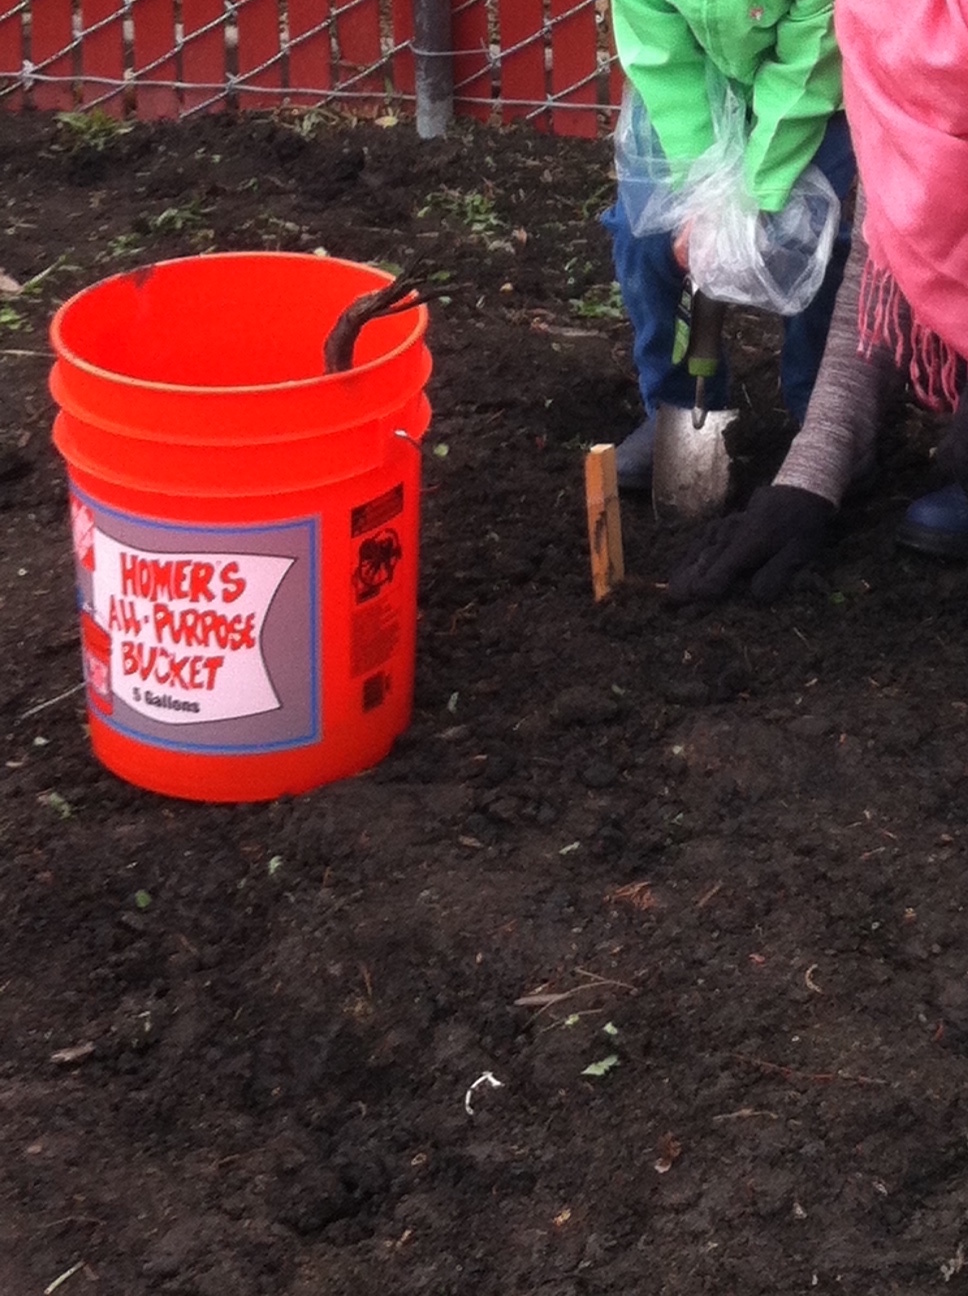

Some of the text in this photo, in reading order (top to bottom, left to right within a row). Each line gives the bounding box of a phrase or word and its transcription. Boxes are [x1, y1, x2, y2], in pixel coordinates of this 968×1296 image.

[120, 552, 246, 603] HOMER'S
[121, 641, 225, 690] BUCKET
[133, 687, 200, 713] 5 Gallons
